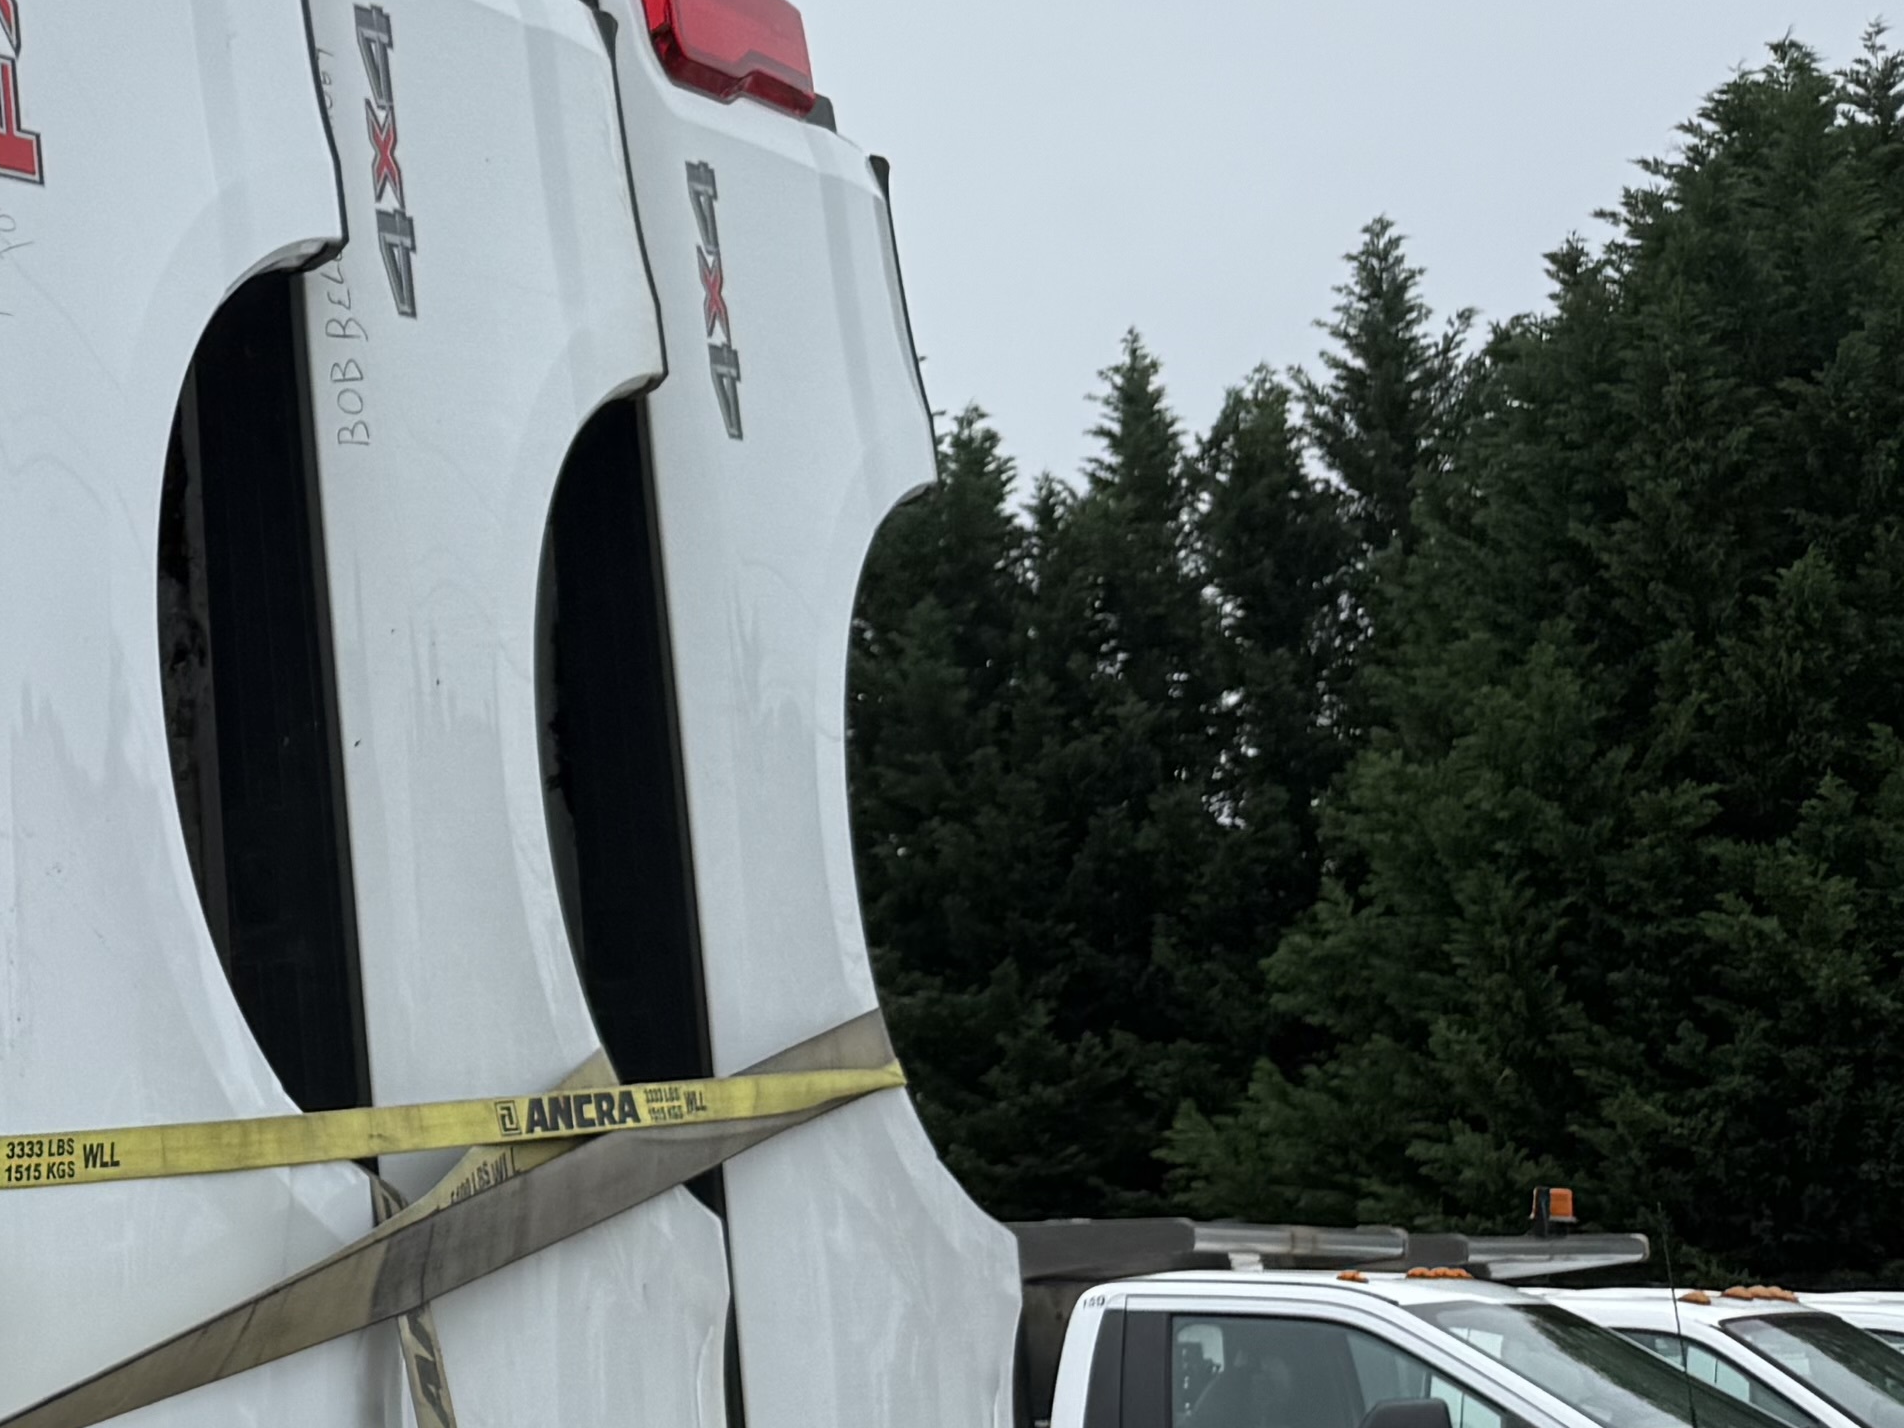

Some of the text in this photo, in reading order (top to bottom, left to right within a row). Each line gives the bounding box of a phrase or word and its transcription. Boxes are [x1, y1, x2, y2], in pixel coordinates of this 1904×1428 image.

[330, 358, 370, 446] BOB
[526, 1090, 641, 1134] ANCRA
[6, 1138, 74, 1160] 3333 LBS
[83, 1142, 120, 1169] WLL
[5, 1160, 75, 1182] 1515 KGS
